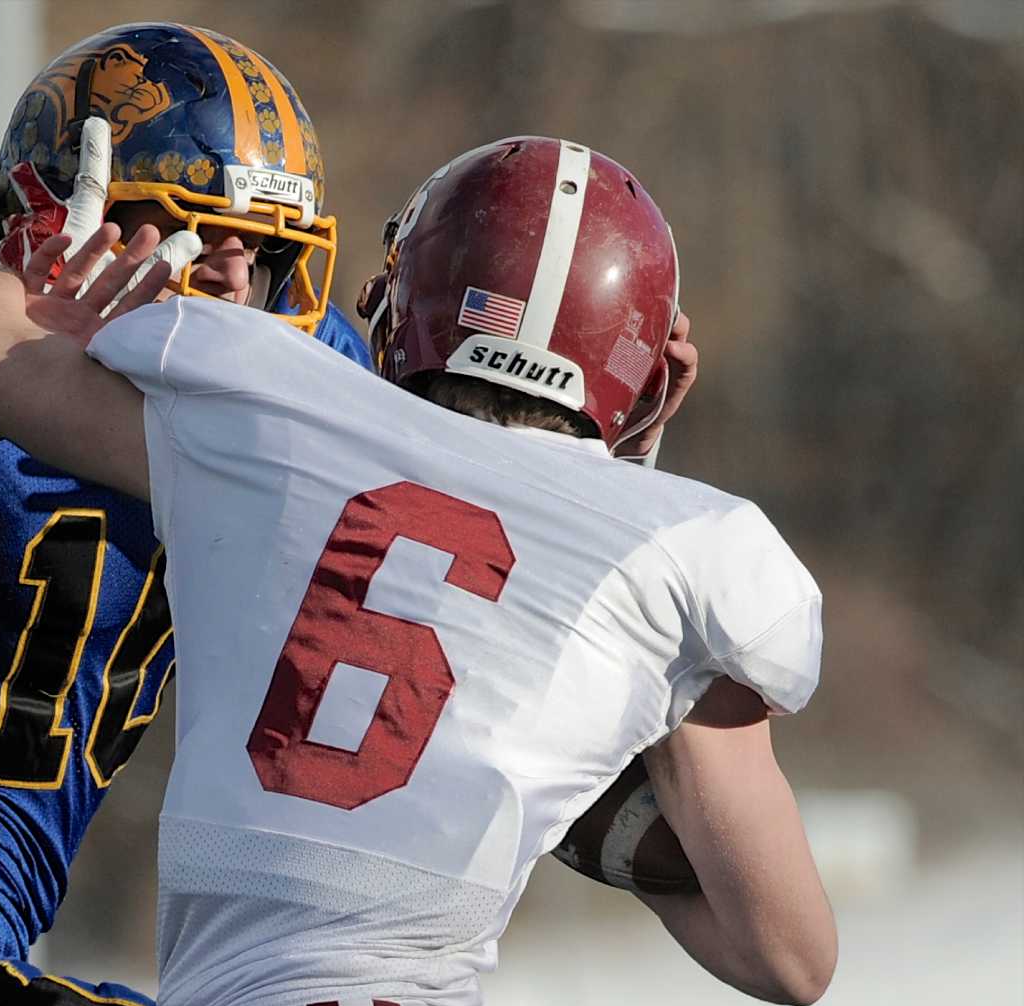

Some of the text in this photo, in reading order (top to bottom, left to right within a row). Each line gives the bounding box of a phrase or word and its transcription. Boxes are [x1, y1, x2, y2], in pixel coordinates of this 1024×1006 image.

[251, 173, 298, 193] schutt
[469, 346, 575, 390] schutt
[246, 480, 517, 811] 6
